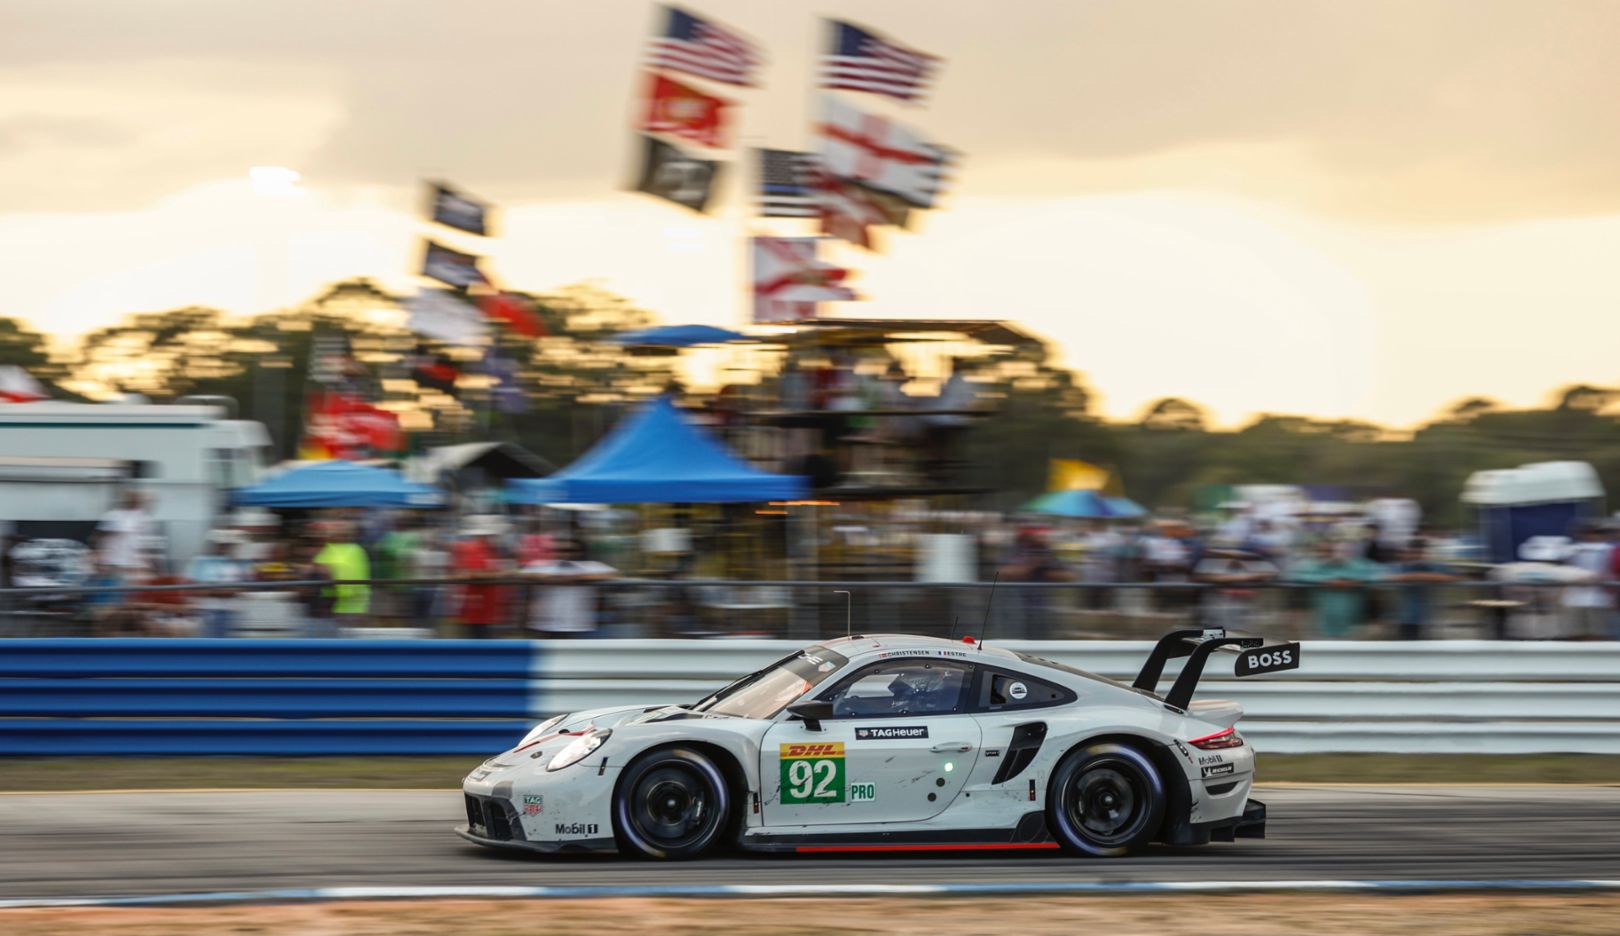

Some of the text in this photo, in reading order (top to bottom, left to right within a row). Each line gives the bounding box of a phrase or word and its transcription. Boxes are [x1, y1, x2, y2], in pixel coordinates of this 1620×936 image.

[1247, 650, 1292, 669] BOSS
[788, 744, 837, 757] DHL
[789, 760, 837, 799] 92
[851, 784, 875, 800] PRO
[555, 822, 586, 835] Mobil
